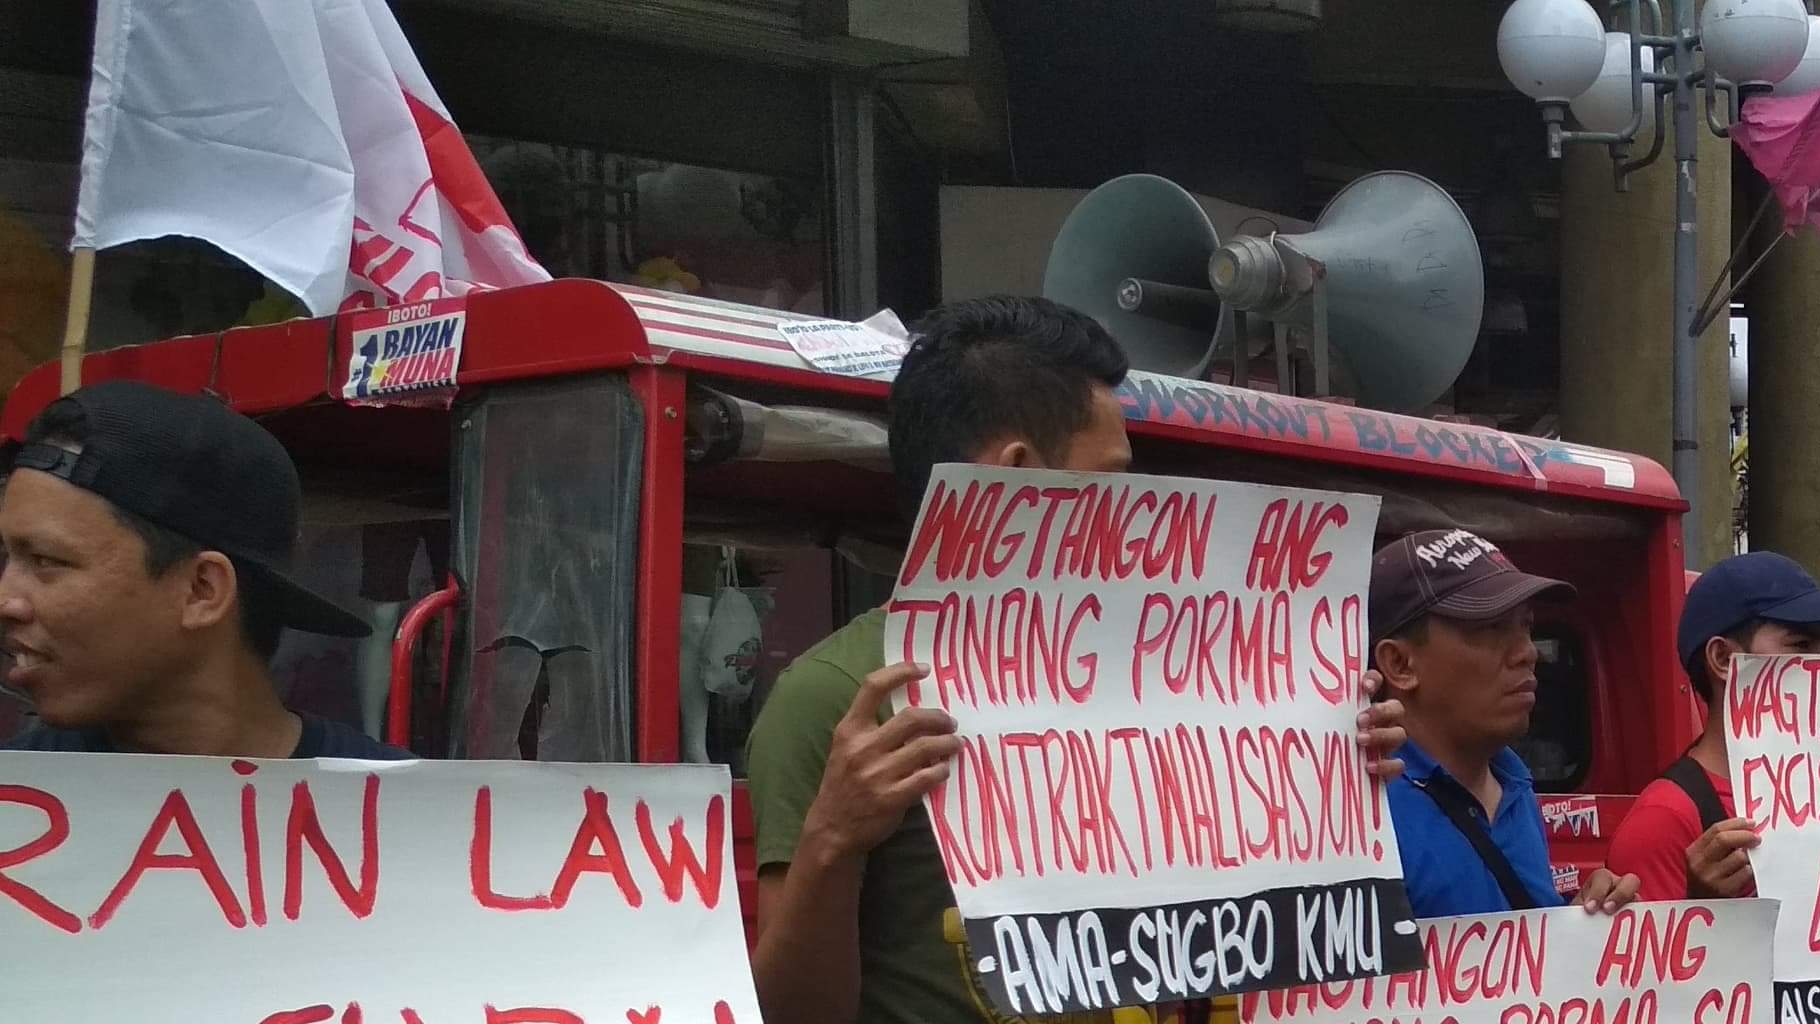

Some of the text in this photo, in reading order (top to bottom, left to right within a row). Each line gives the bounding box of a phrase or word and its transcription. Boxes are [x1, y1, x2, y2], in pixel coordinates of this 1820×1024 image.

[382, 317, 459, 360] BAYAN
[1136, 378, 1333, 441] WORKOUT
[900, 479, 1348, 594] WAGTANGON ANG
[890, 586, 1366, 711] TANANG PORMA SA
[469, 783, 726, 912] LAW
[1597, 905, 1716, 989] ANG
